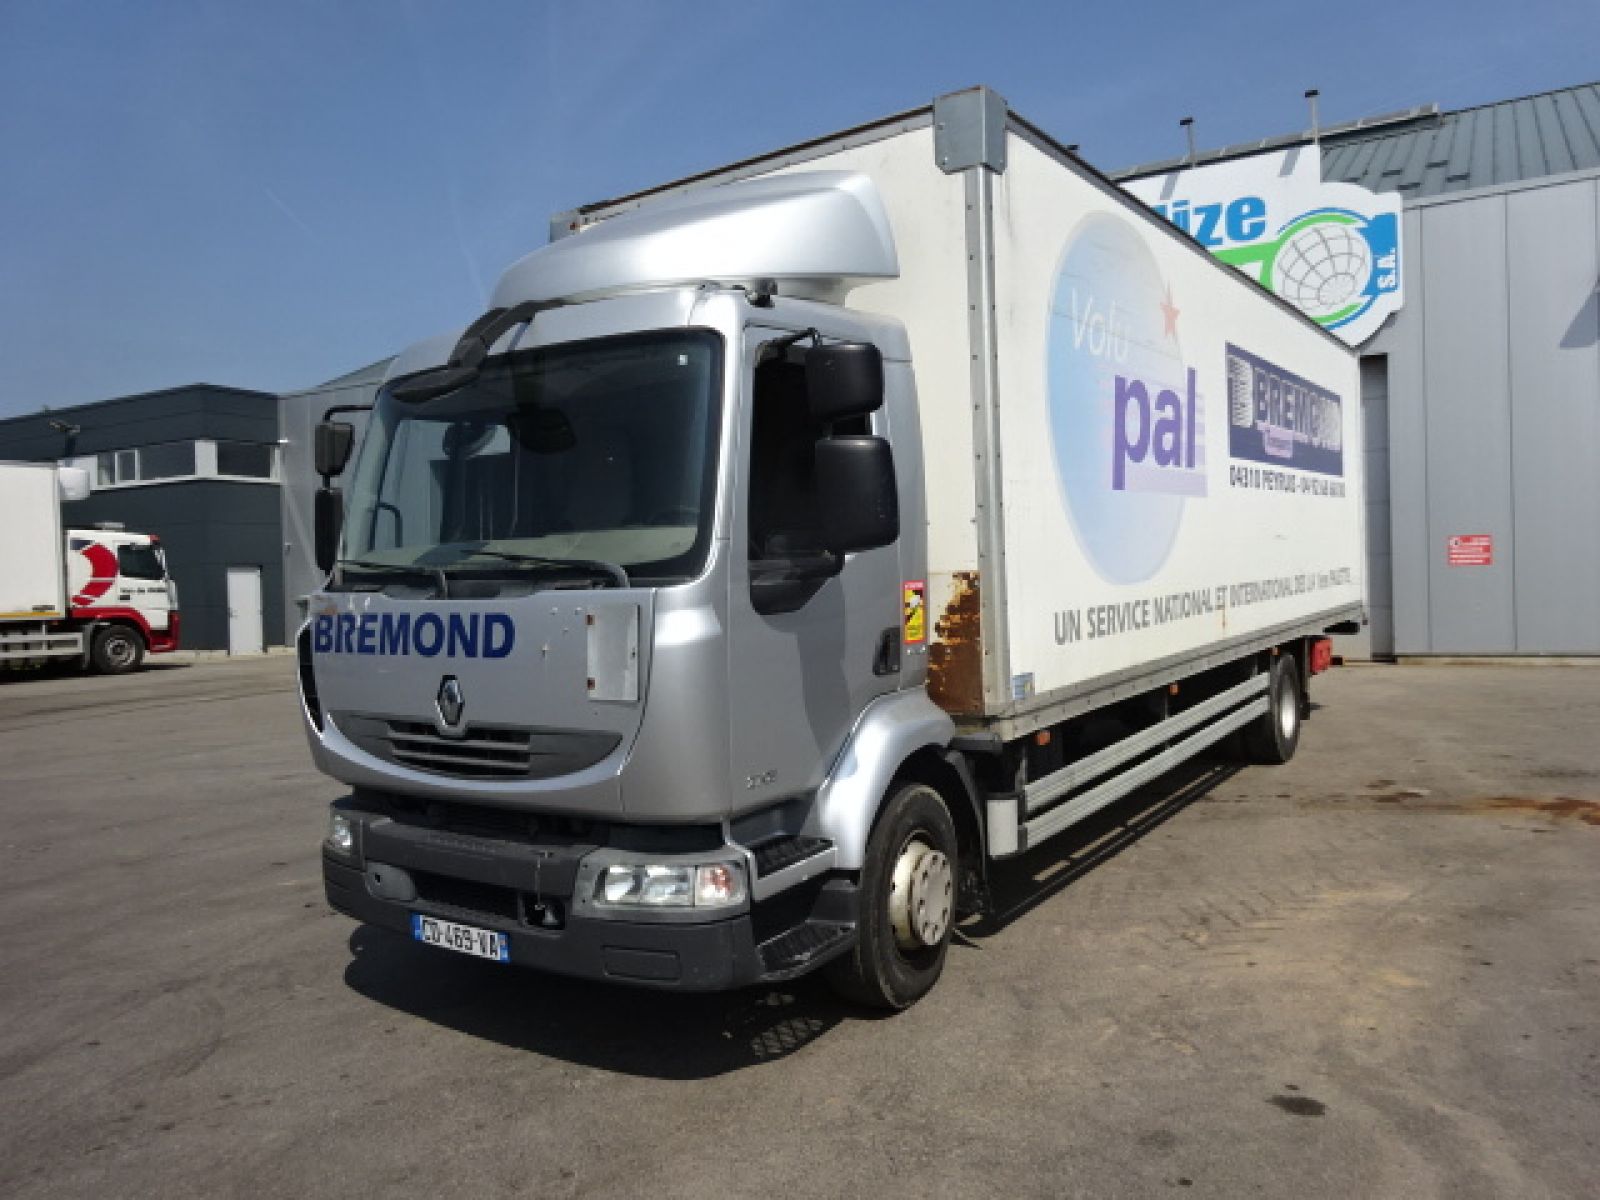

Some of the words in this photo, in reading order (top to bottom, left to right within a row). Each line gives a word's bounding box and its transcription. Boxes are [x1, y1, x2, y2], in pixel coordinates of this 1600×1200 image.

[1151, 197, 1266, 246] ize
[1071, 288, 1129, 365] Volu
[1112, 367, 1196, 490] pal
[313, 611, 516, 659] BREMOND
[1054, 608, 1081, 645] UN
[1087, 599, 1150, 639] SERVICE
[1154, 587, 1212, 625] NATIONAL
